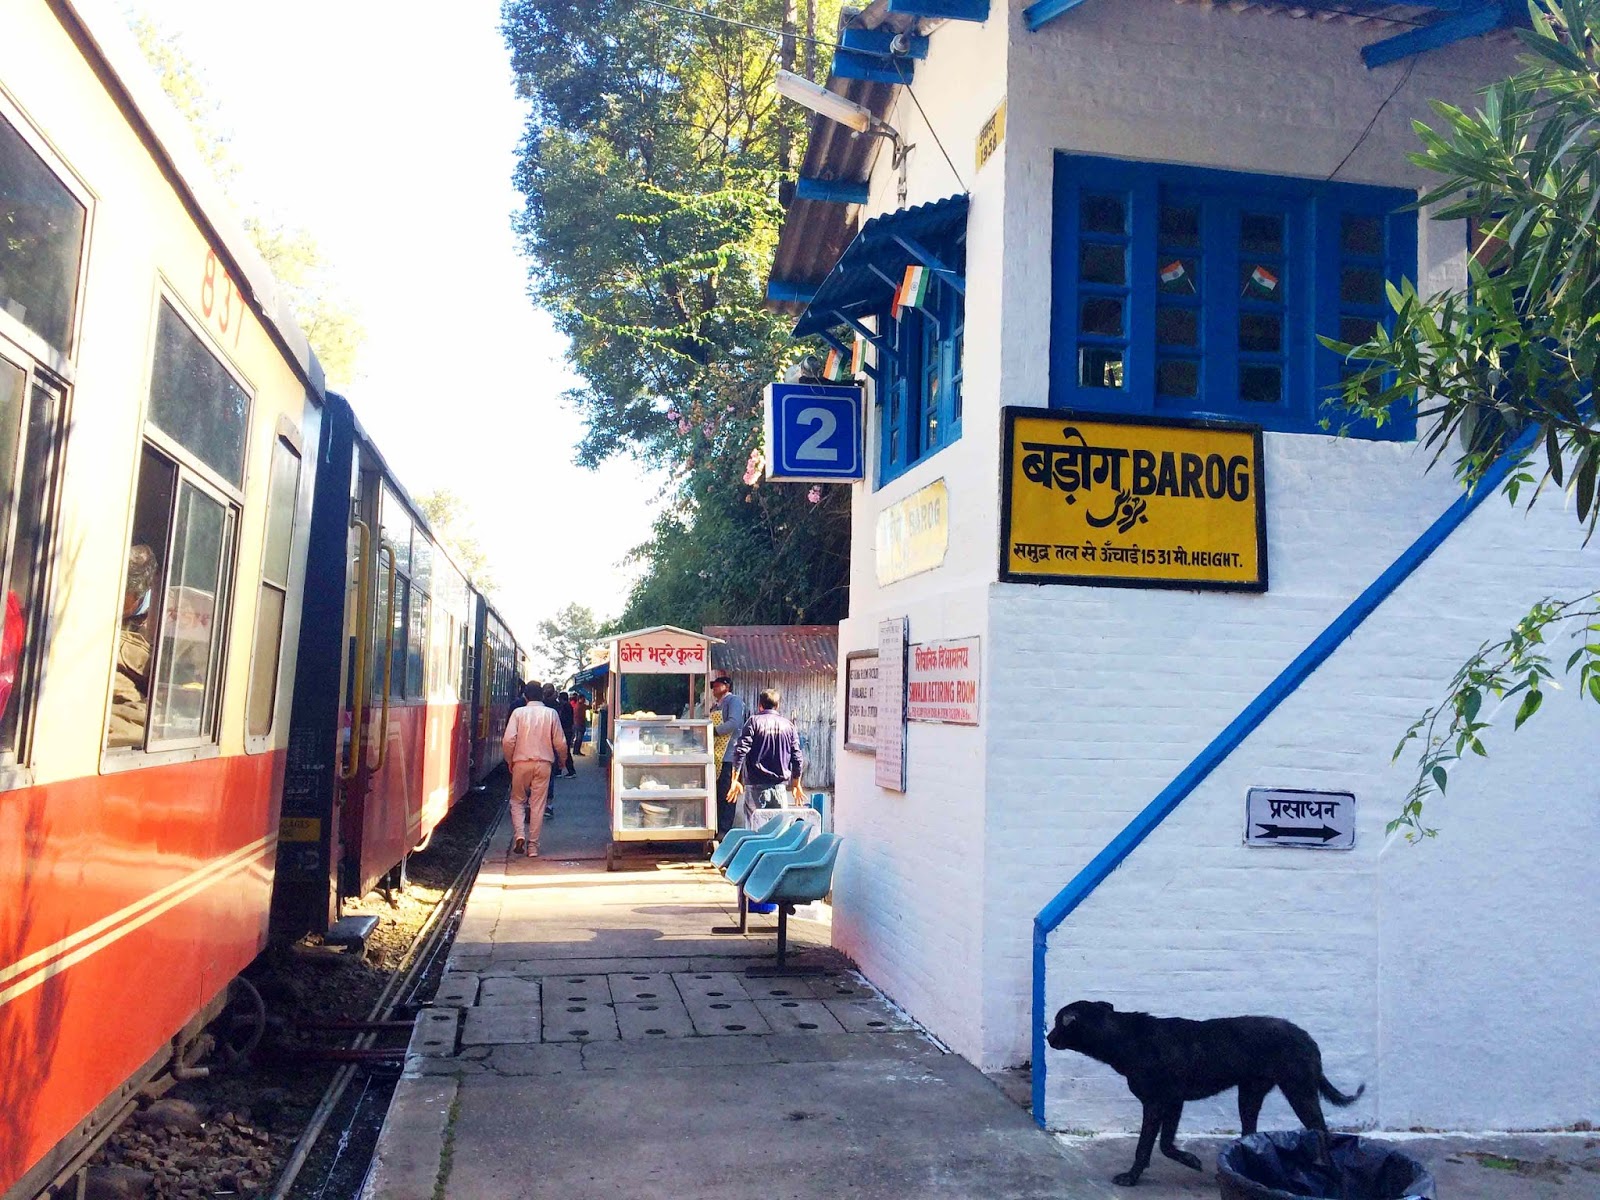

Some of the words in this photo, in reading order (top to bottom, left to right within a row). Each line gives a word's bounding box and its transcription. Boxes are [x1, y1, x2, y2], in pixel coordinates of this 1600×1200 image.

[796, 407, 838, 462] 2
[1021, 427, 1130, 504] बड़ोग
[1132, 449, 1249, 501] BAROG
[1013, 543, 1051, 563] समुद्र
[1081, 540, 1097, 562] से
[1141, 549, 1171, 565] 1531
[928, 681, 954, 703] RETIRING
[956, 680, 976, 703] ROOM
[1267, 799, 1341, 819] प्रसाधन
